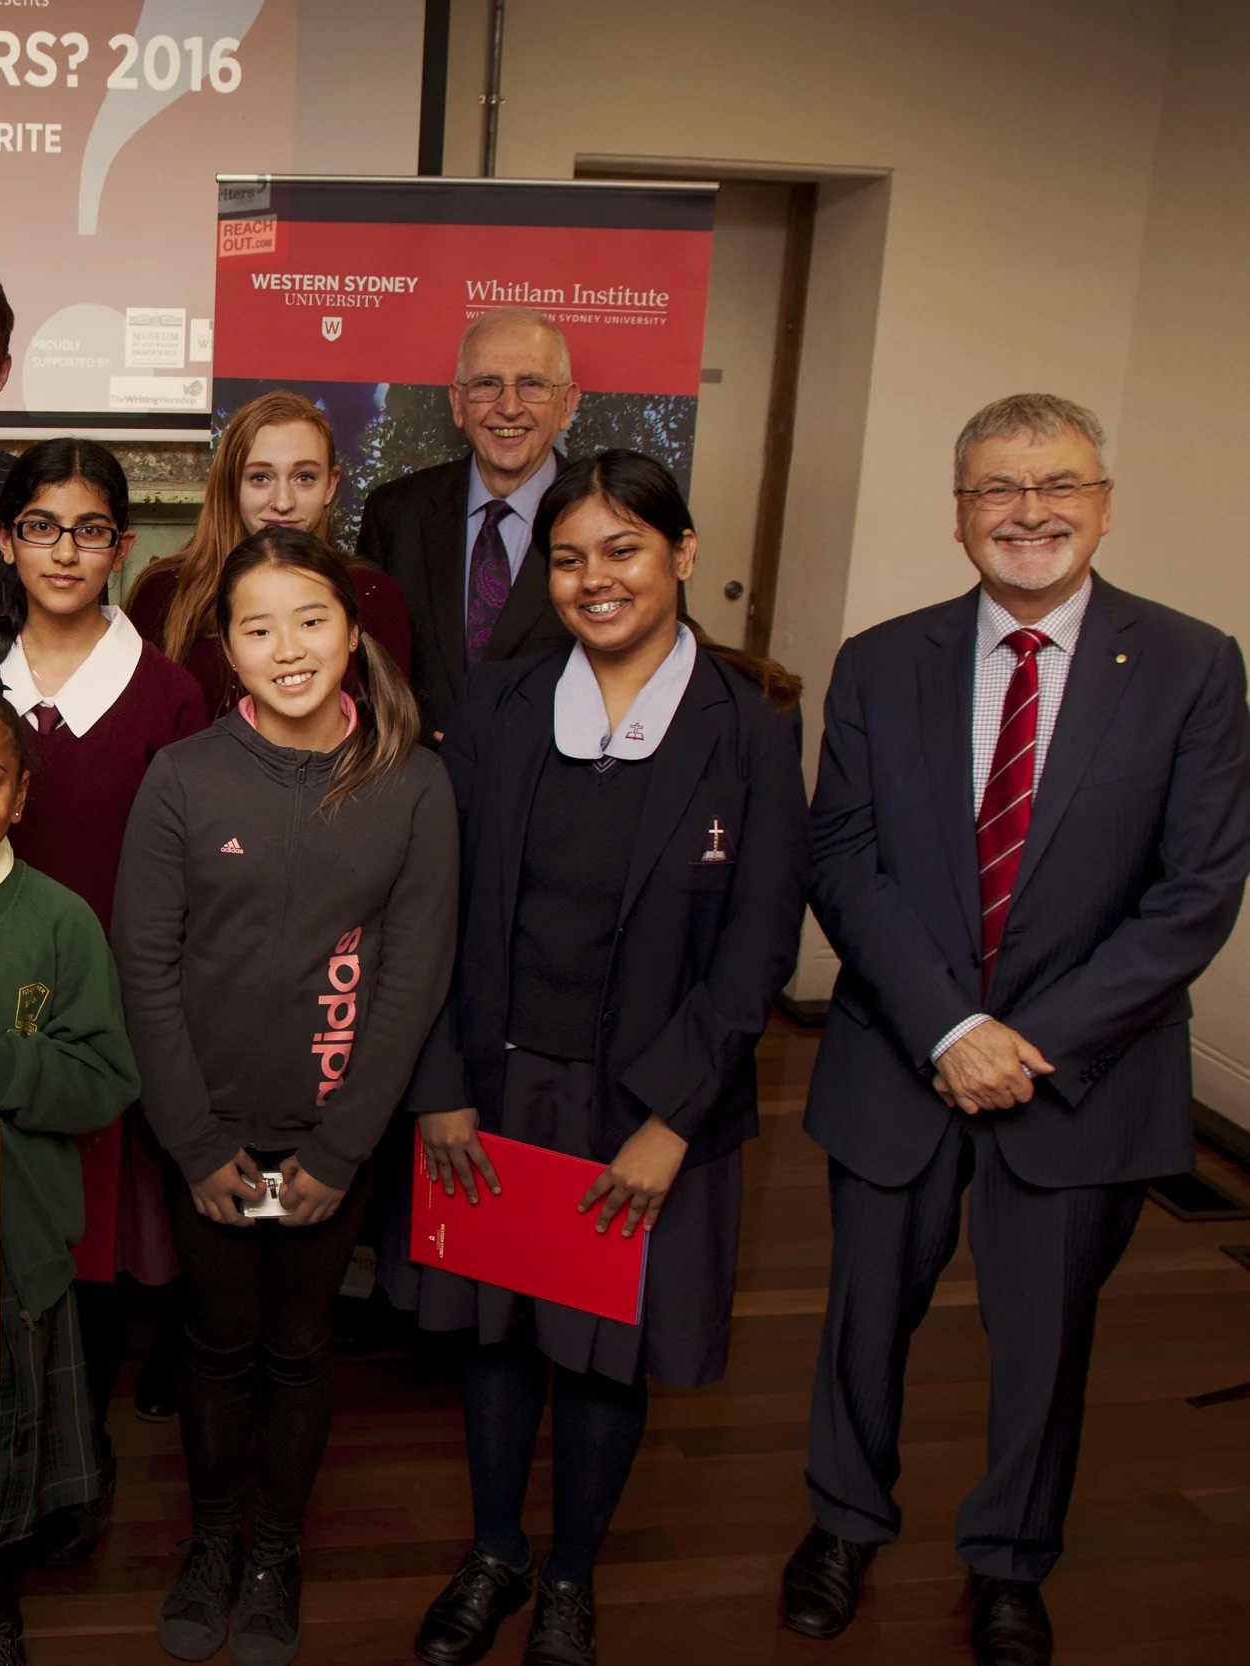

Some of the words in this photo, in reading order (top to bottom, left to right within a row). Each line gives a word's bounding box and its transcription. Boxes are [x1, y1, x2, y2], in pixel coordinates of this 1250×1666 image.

[106, 33, 242, 94] 2016
[223, 220, 273, 237] REACH
[251, 273, 339, 291] WESTERN
[344, 275, 418, 293] SYDNEY
[284, 293, 383, 308] UNIVERSITY
[465, 279, 565, 303] Whitlam
[572, 283, 669, 307] Institute
[324, 320, 340, 335] W
[559, 314, 601, 323] SYDNEY
[604, 316, 667, 326] UNIVERSITY
[132, 330, 178, 341] MUSEUM
[33, 339, 81, 351] PROUDLY
[33, 357, 94, 368] SUPPORTED
[98, 358, 113, 368] BY:
[221, 846, 244, 855] adidas
